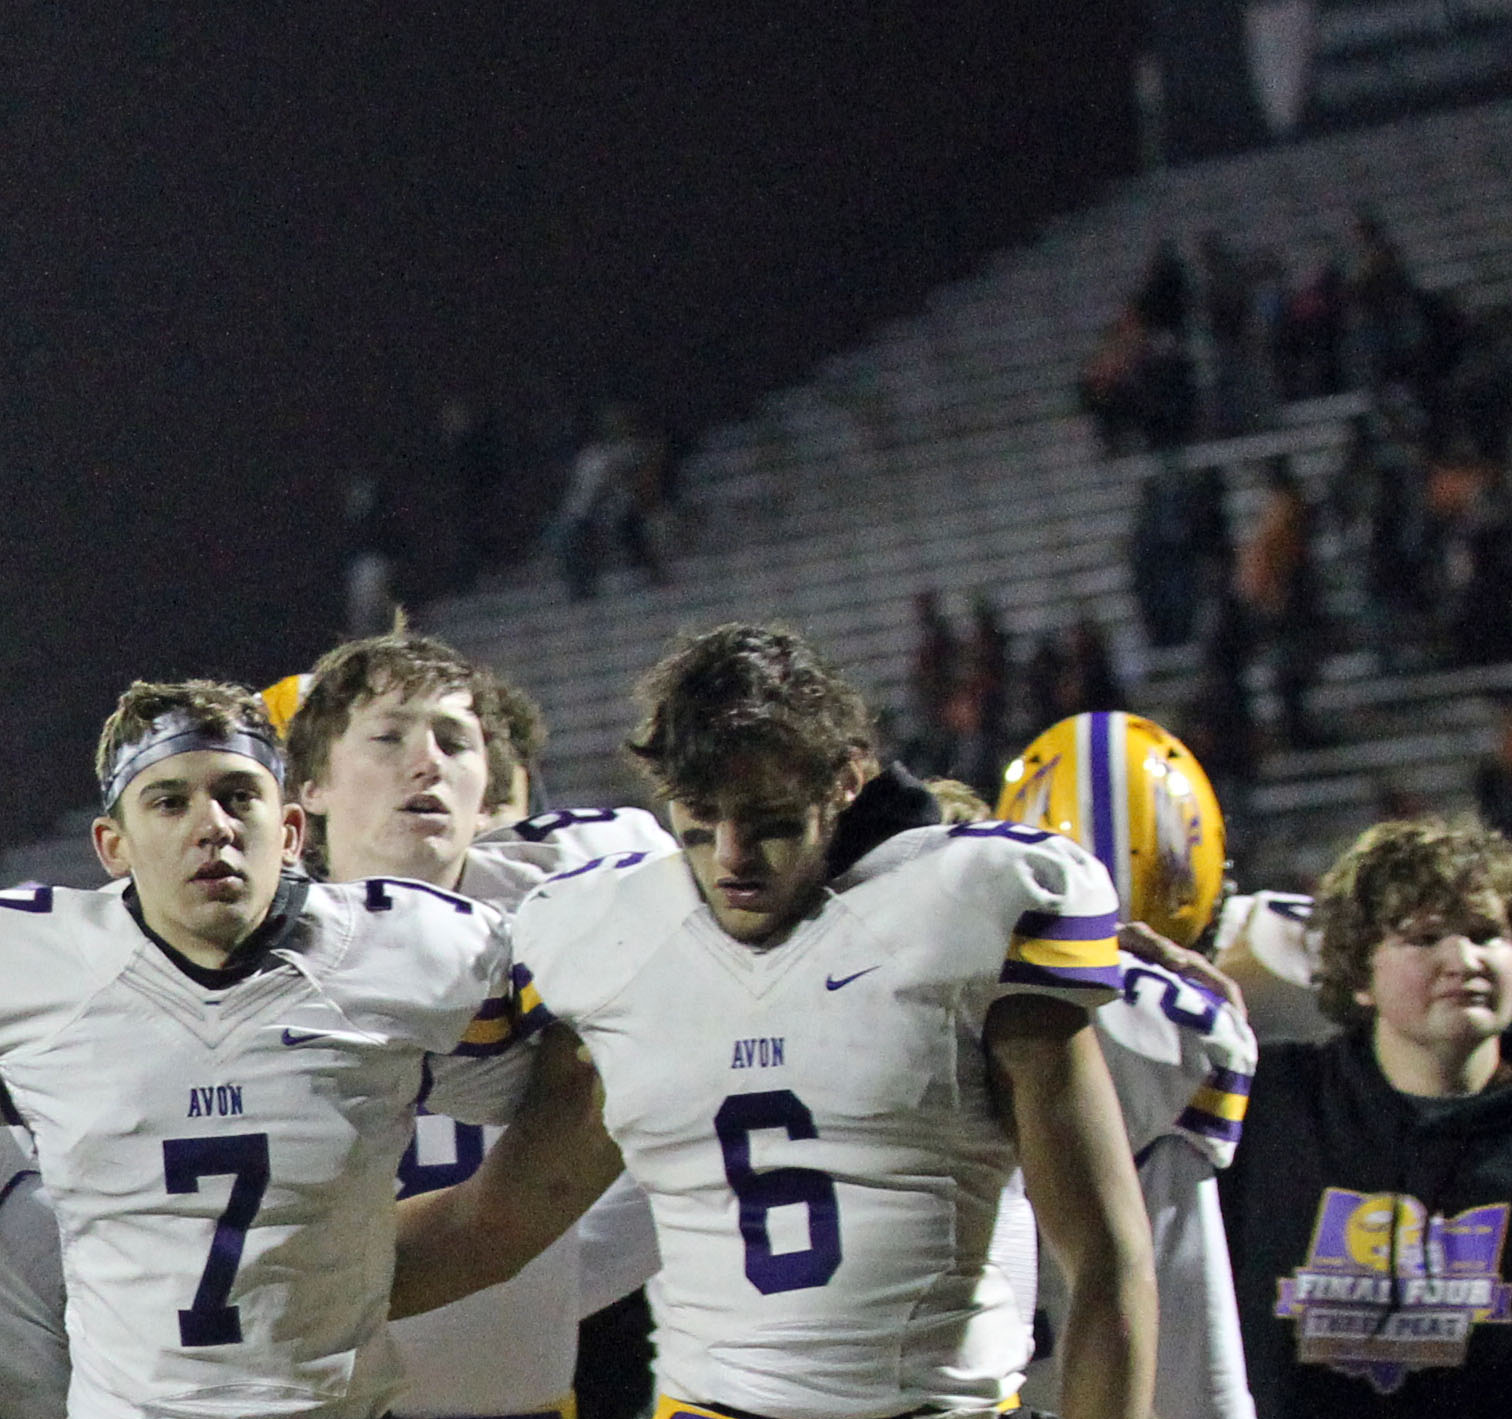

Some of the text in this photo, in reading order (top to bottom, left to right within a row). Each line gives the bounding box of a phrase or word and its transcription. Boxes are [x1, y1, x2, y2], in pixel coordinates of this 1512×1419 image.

[187, 1086, 243, 1118] AVON
[731, 1037, 785, 1069] AVON
[162, 1132, 270, 1346] 7
[714, 1089, 843, 1295] 6
